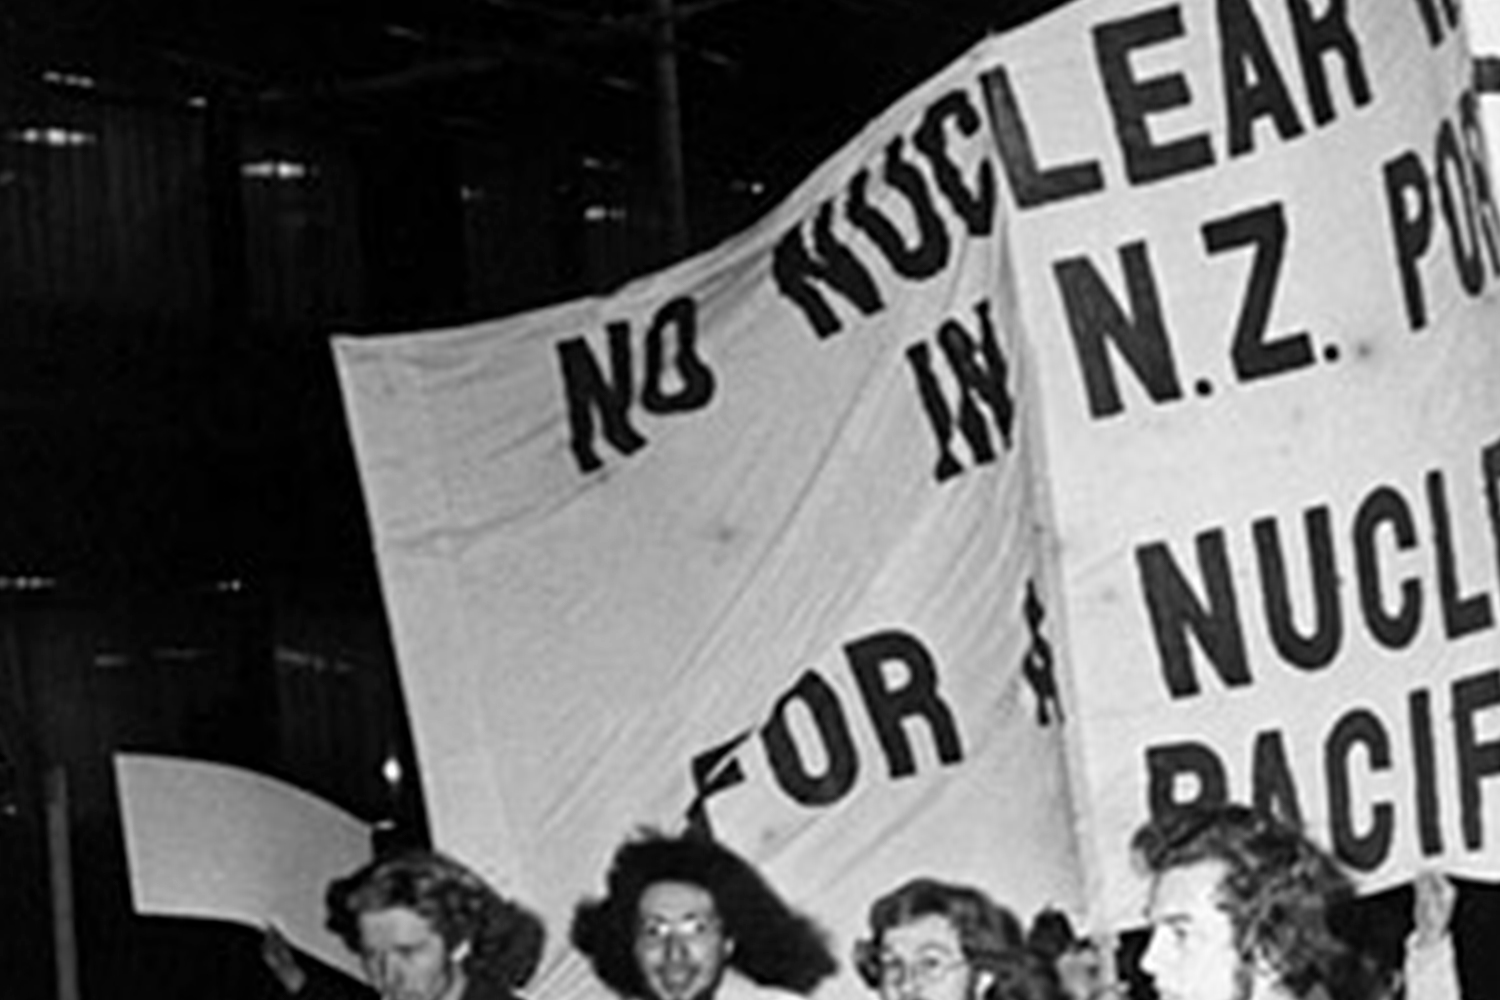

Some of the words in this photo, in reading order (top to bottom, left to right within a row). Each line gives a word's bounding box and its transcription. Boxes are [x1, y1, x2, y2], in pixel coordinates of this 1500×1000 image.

[556, 296, 715, 475] NO
[771, 0, 1373, 340] NUCLEAR
[906, 299, 1014, 484] IN
[1052, 201, 1341, 420] N.Z.
[686, 629, 965, 838] FOR
